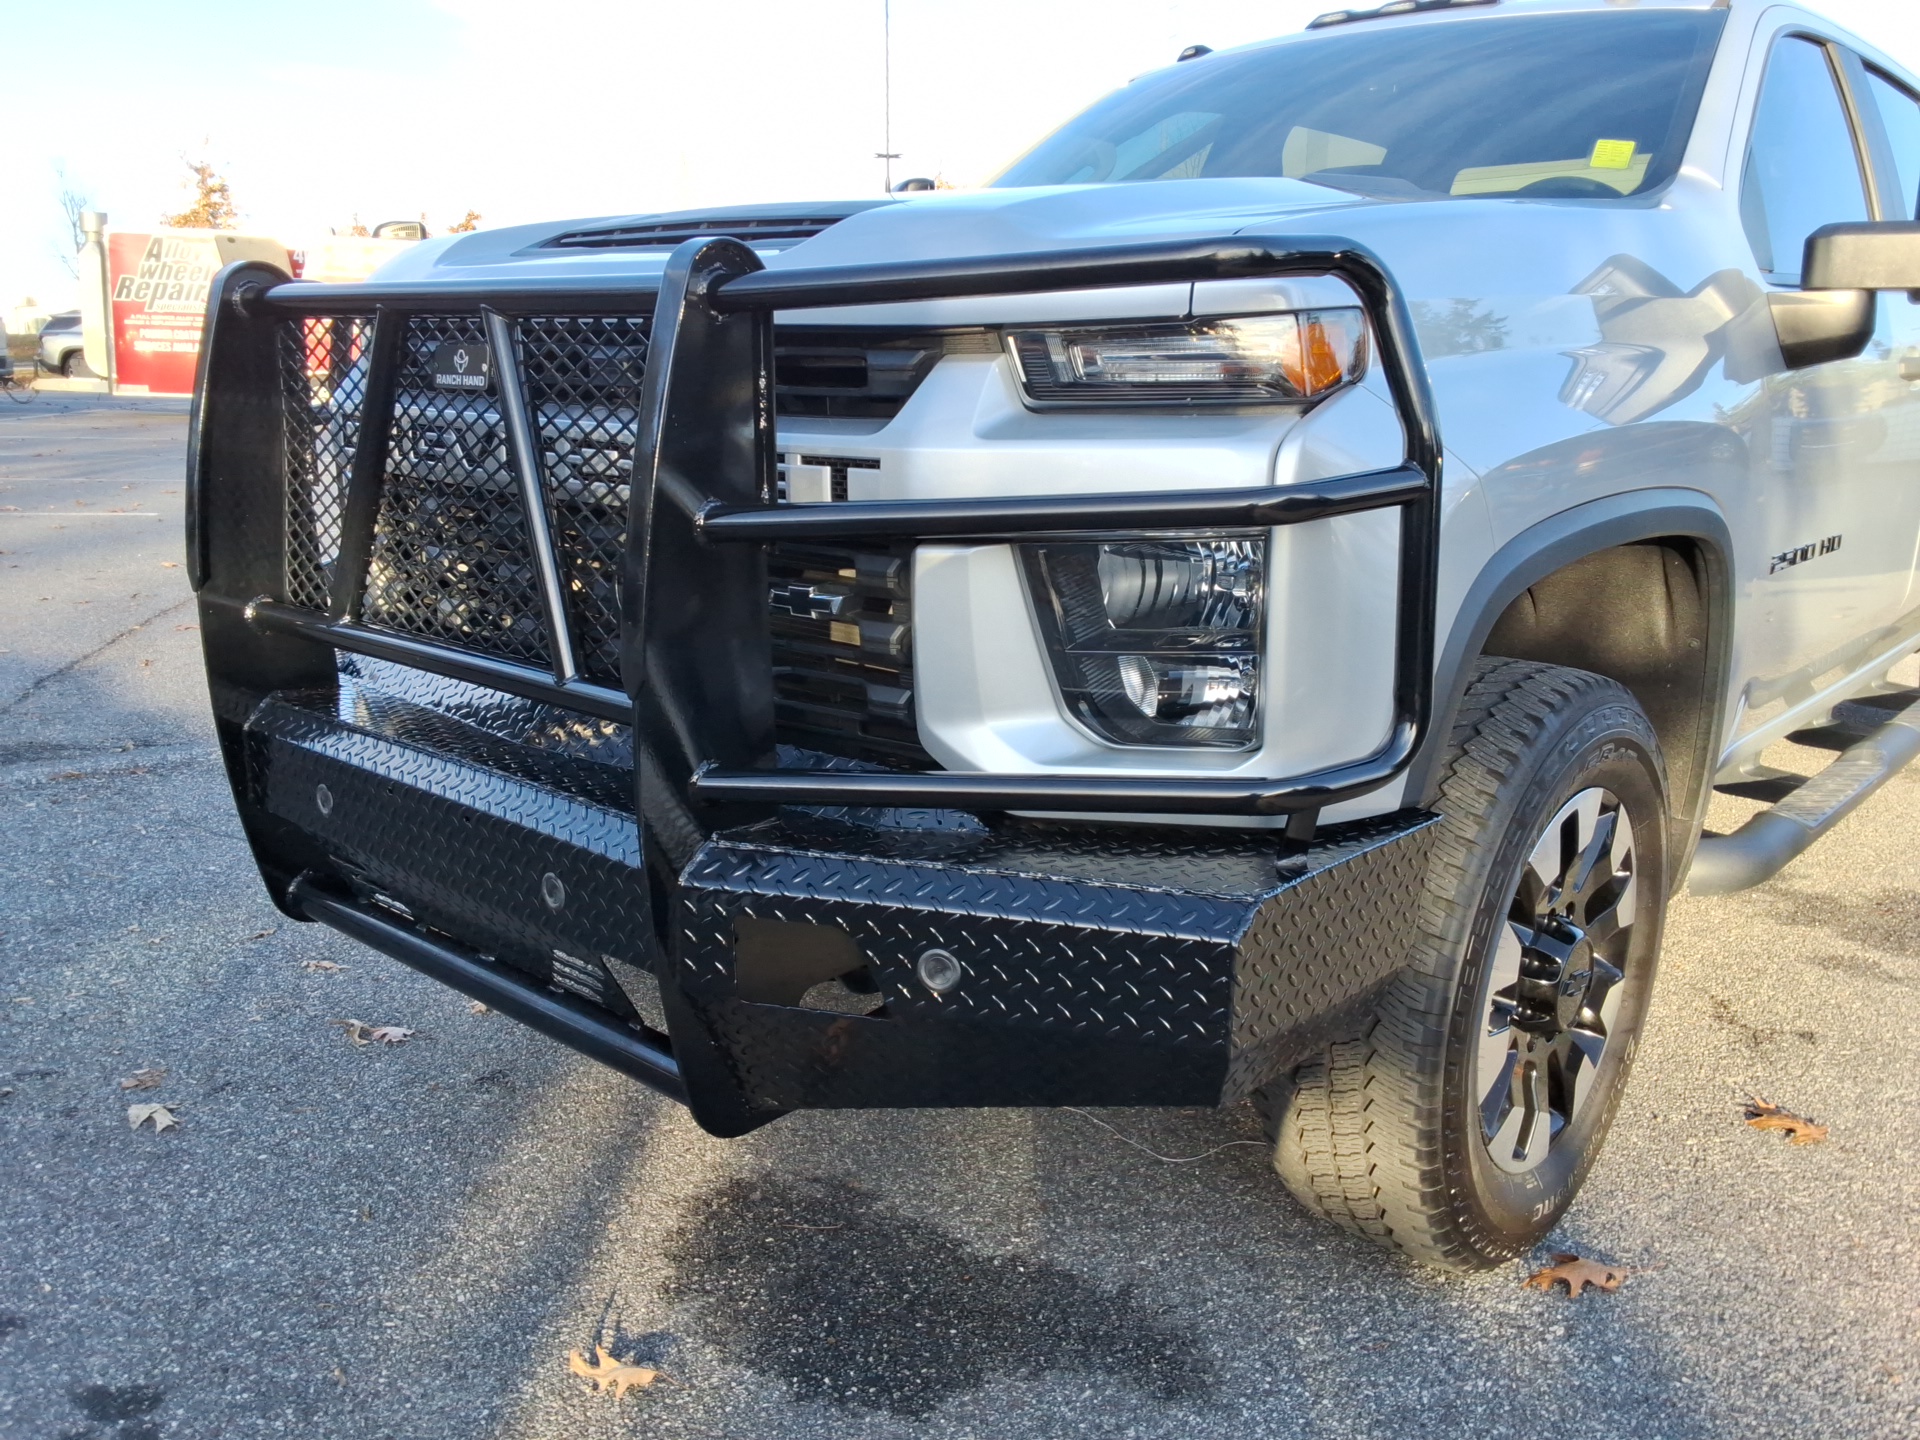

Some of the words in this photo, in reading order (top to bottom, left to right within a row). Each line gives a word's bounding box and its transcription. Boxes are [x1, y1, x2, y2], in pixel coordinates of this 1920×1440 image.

[139, 261, 212, 282] wheel
[436, 374, 461, 385] RANCH
[462, 375, 485, 386] HAND
[1819, 534, 1842, 556] HD
